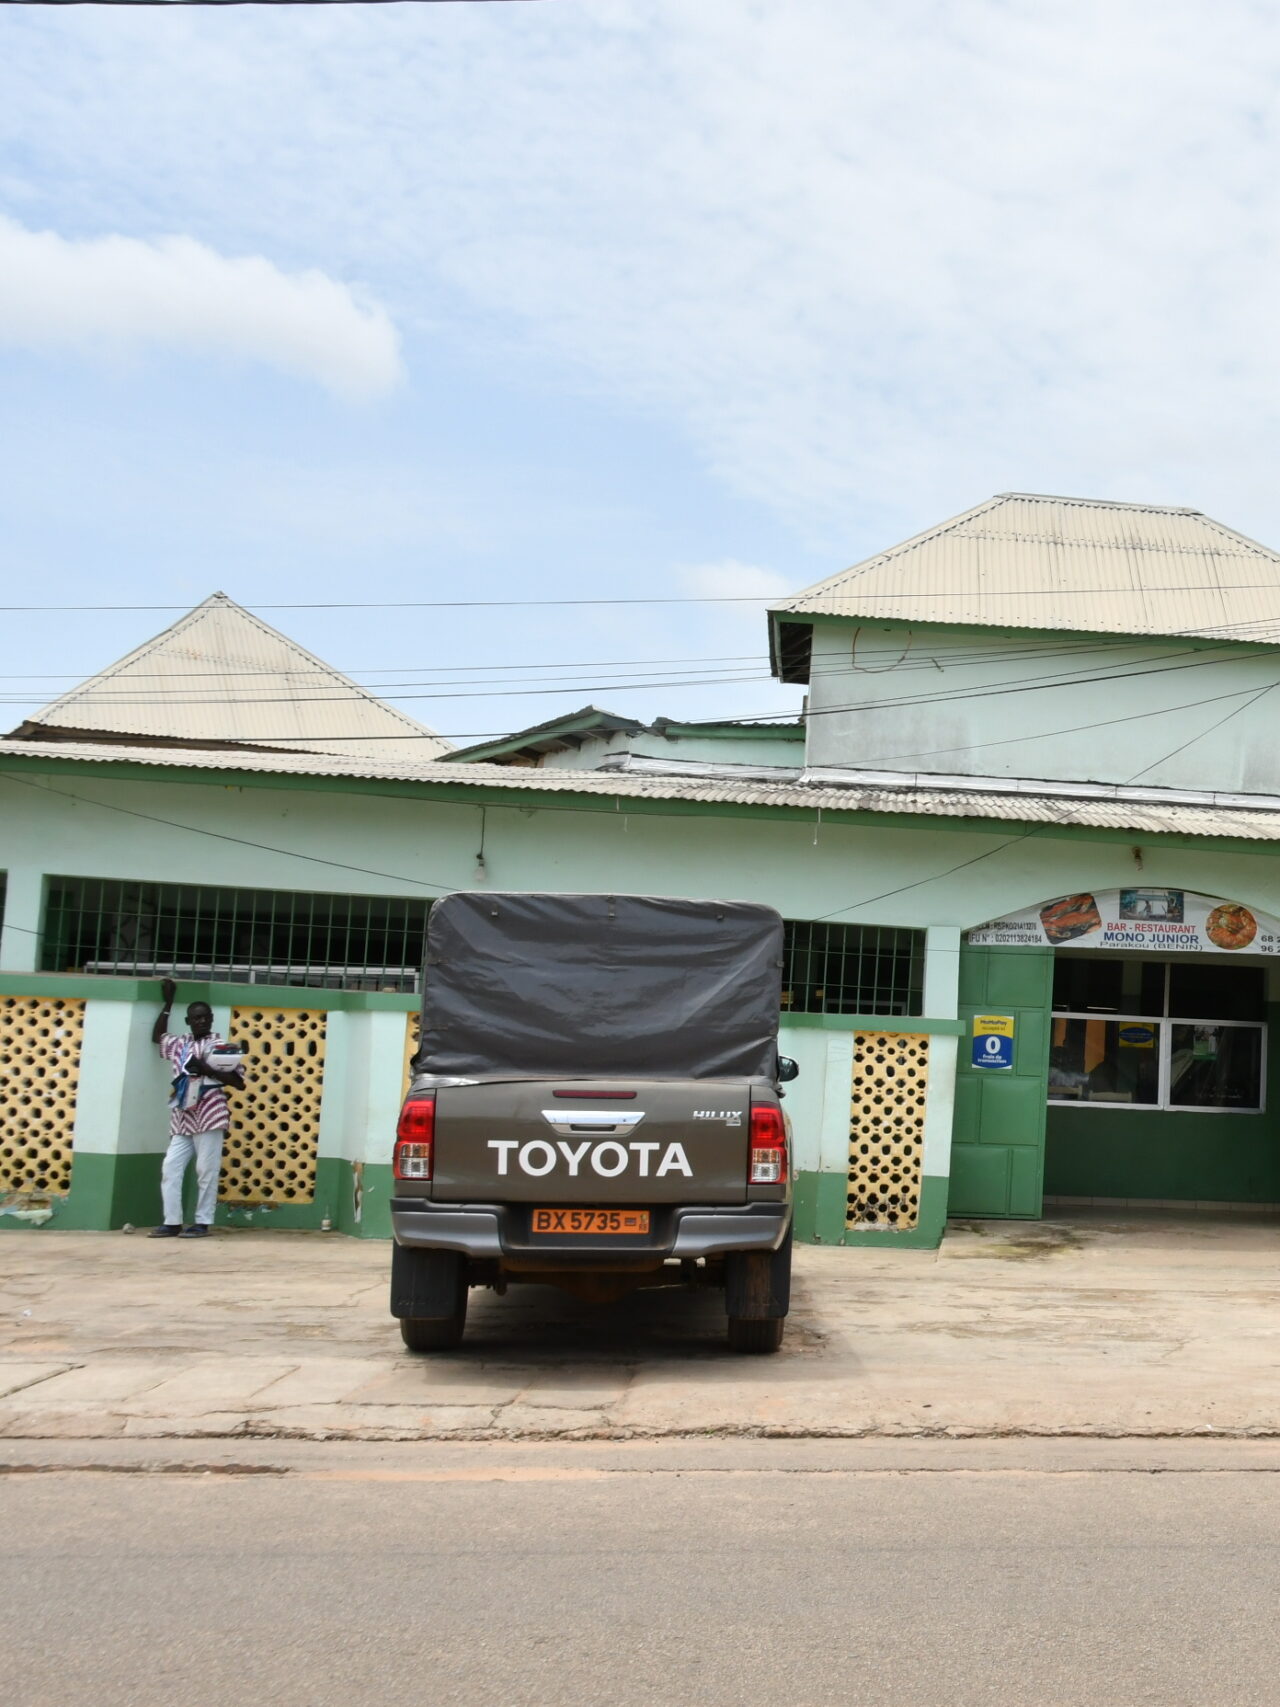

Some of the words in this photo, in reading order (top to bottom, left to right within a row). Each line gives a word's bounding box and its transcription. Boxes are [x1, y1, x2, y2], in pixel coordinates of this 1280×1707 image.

[1107, 923, 1126, 931] BAR
[1135, 924, 1196, 933] RESTAURANT
[1104, 932, 1145, 942] MONO
[1149, 934, 1199, 944] JUNIOR
[1261, 935, 1274, 943] 68
[1153, 943, 1203, 951] (BENIN)
[1261, 945, 1274, 953] 96
[986, 1036, 1001, 1054] 0
[692, 1110, 742, 1120] HILUX
[487, 1140, 693, 1177] TOYOTA
[537, 1212, 566, 1230] BX
[570, 1212, 621, 1231] 5735
